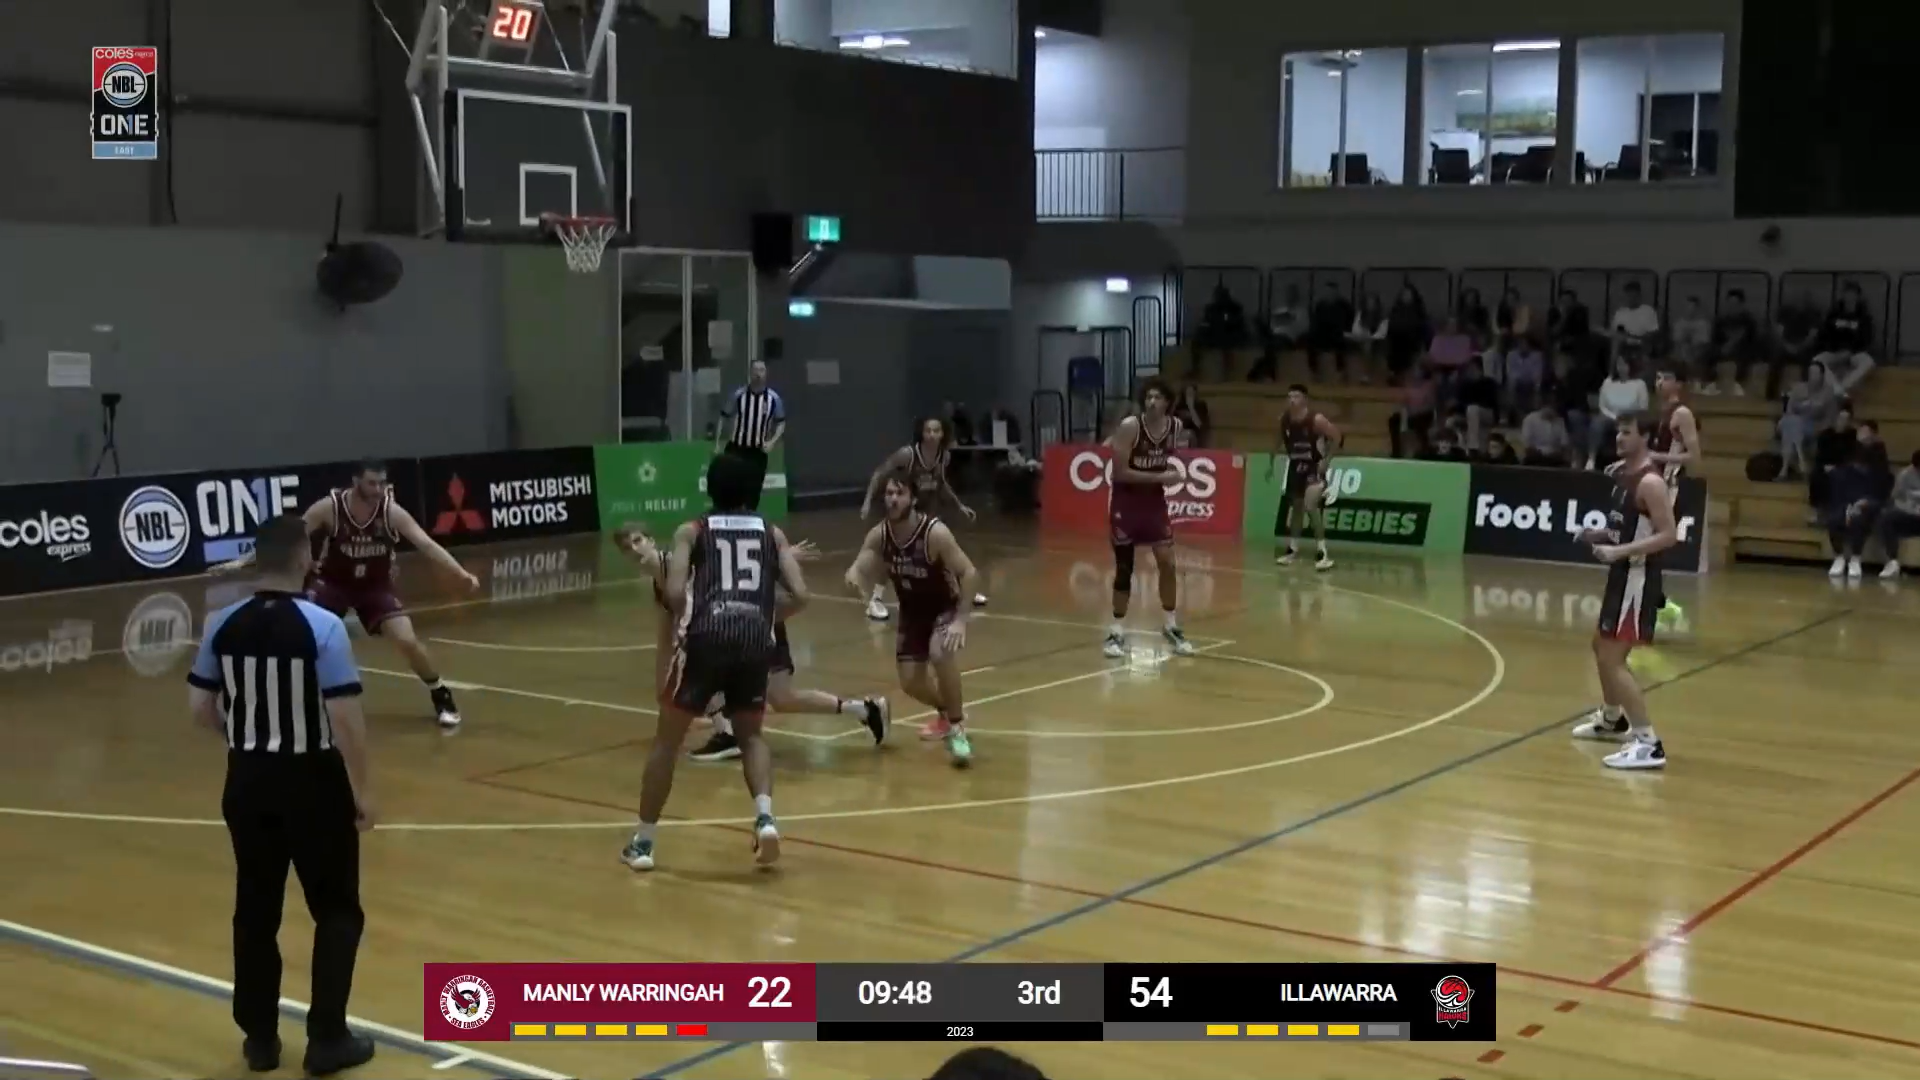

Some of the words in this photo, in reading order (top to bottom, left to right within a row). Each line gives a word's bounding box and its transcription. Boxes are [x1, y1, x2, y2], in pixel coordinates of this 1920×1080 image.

[493, 6, 532, 40] 20
[489, 474, 593, 503] MITSUBISHI
[0, 510, 91, 548] coles
[135, 509, 176, 543] NBL
[491, 501, 569, 529] MOTORS
[1475, 493, 1553, 532] Foot
[46, 541, 92, 562] express
[716, 538, 761, 592] 15
